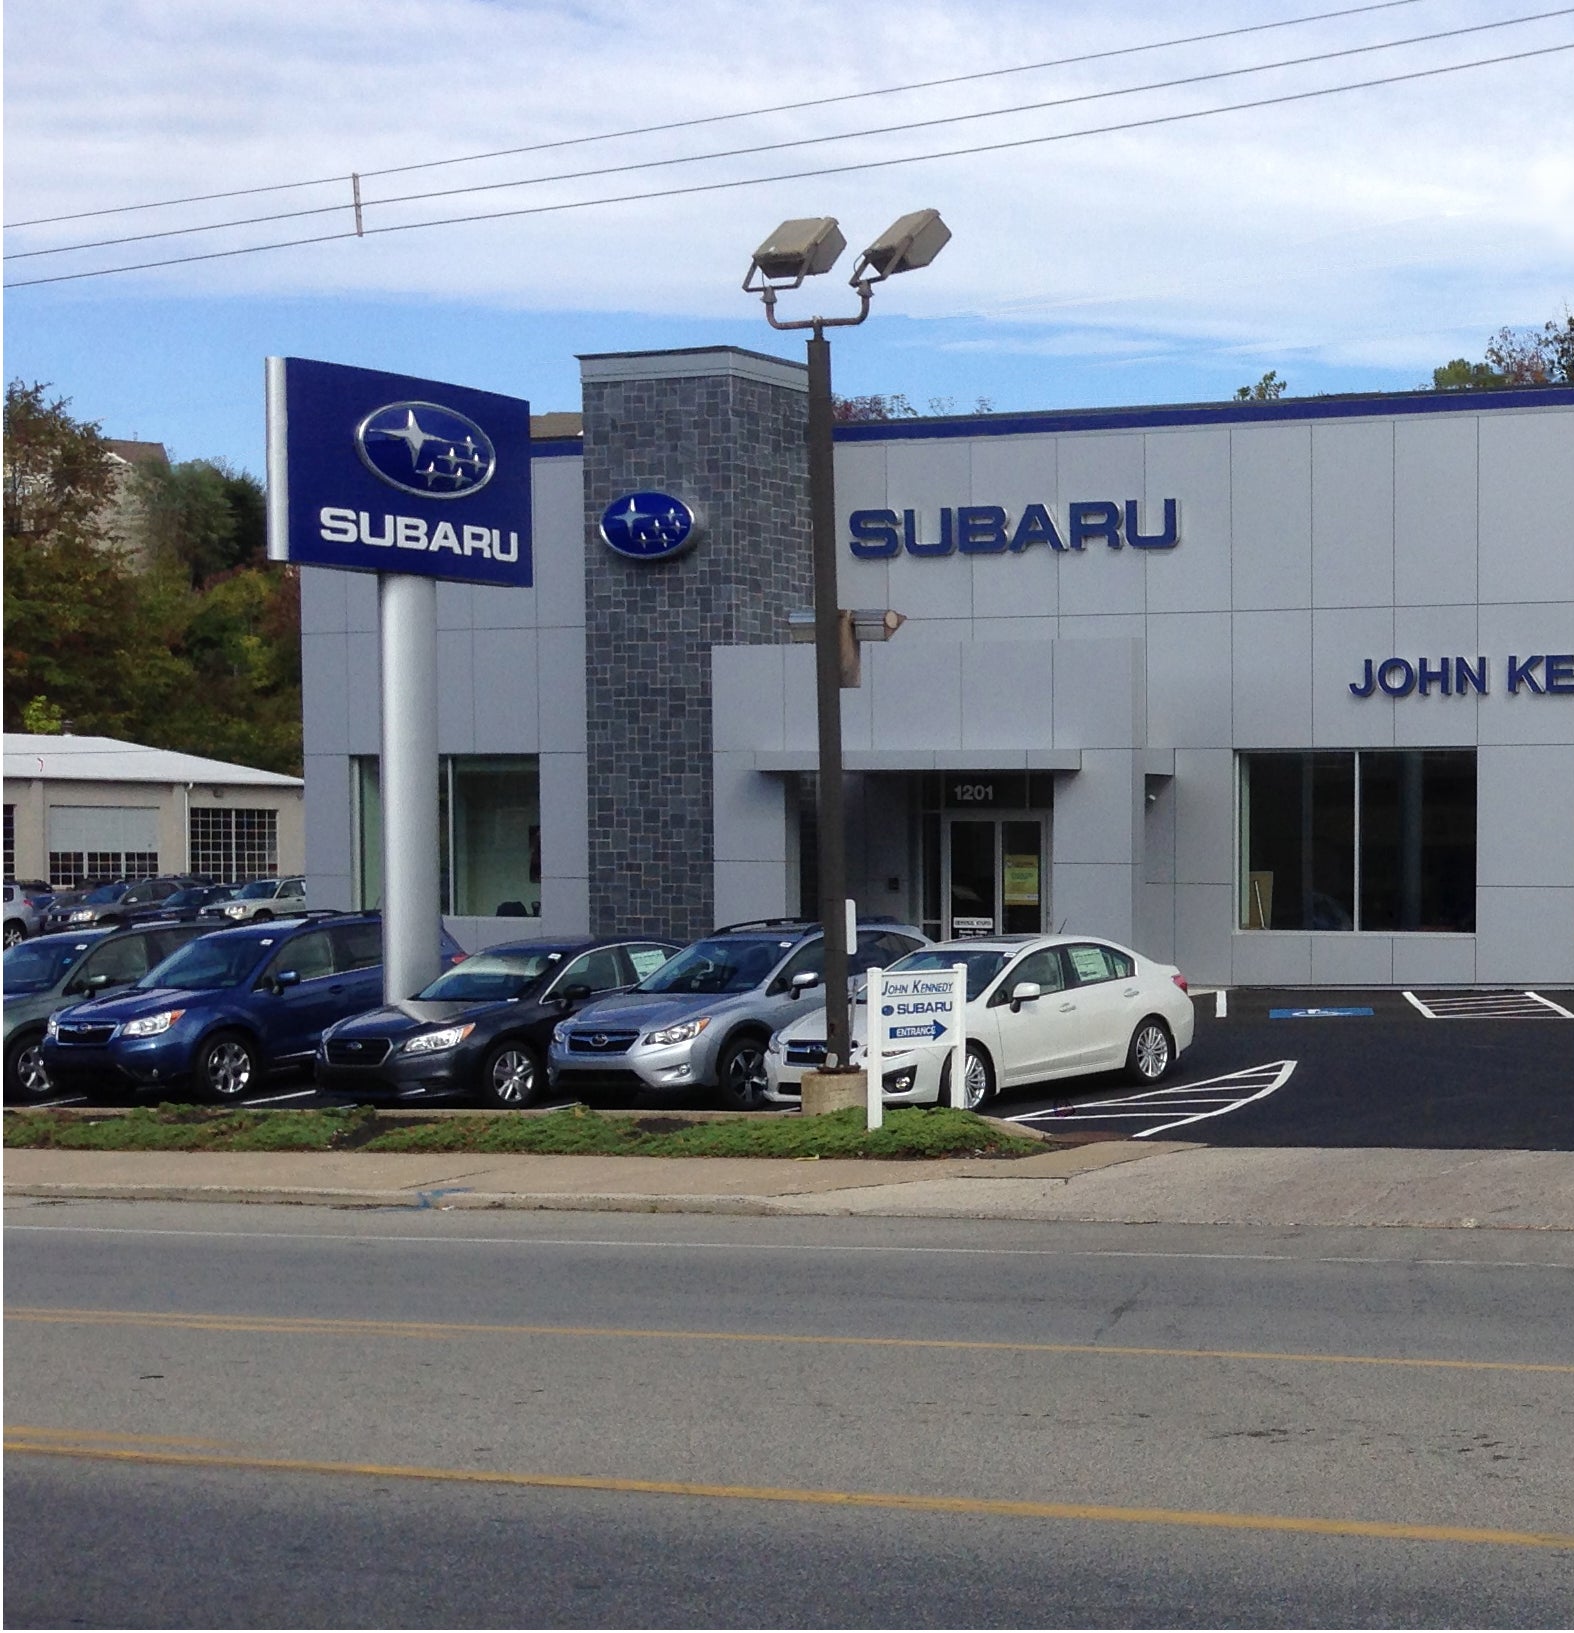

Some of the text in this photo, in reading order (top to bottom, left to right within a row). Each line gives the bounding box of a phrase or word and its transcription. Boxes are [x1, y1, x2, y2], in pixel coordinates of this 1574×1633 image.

[320, 506, 519, 563] SUBARU
[849, 498, 1179, 559] SUBARU
[1348, 656, 1488, 697] JOHN
[954, 785, 994, 801] 1201
[881, 979, 954, 996] JOHN KENNEDY
[897, 1001, 953, 1015] SUBARU
[896, 1025, 937, 1037] ENTRANCE
